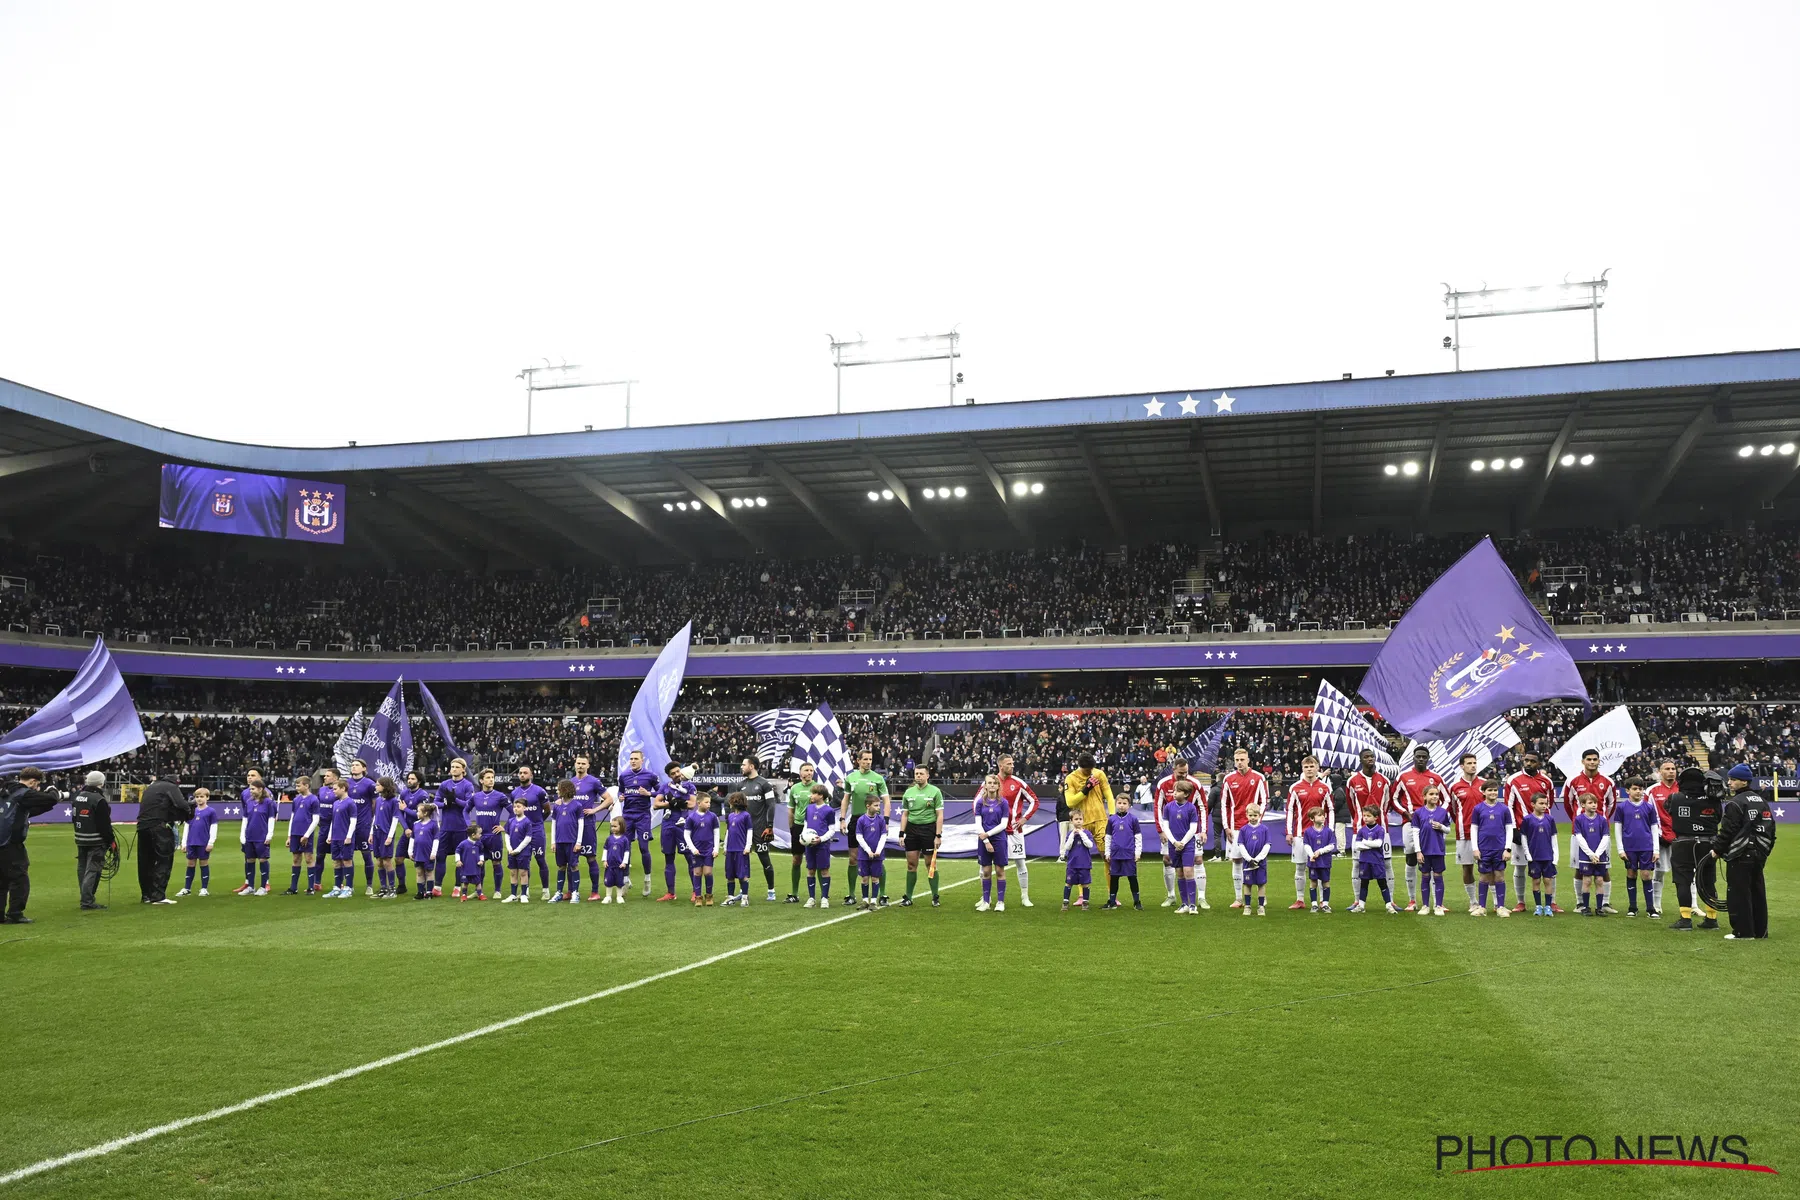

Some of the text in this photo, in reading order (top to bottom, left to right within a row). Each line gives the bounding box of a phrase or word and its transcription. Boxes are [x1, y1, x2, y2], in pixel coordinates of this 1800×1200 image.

[643, 832, 649, 840] 6
[581, 845, 592, 853] 32
[756, 843, 767, 852] 26
[1013, 844, 1023, 853] 23
